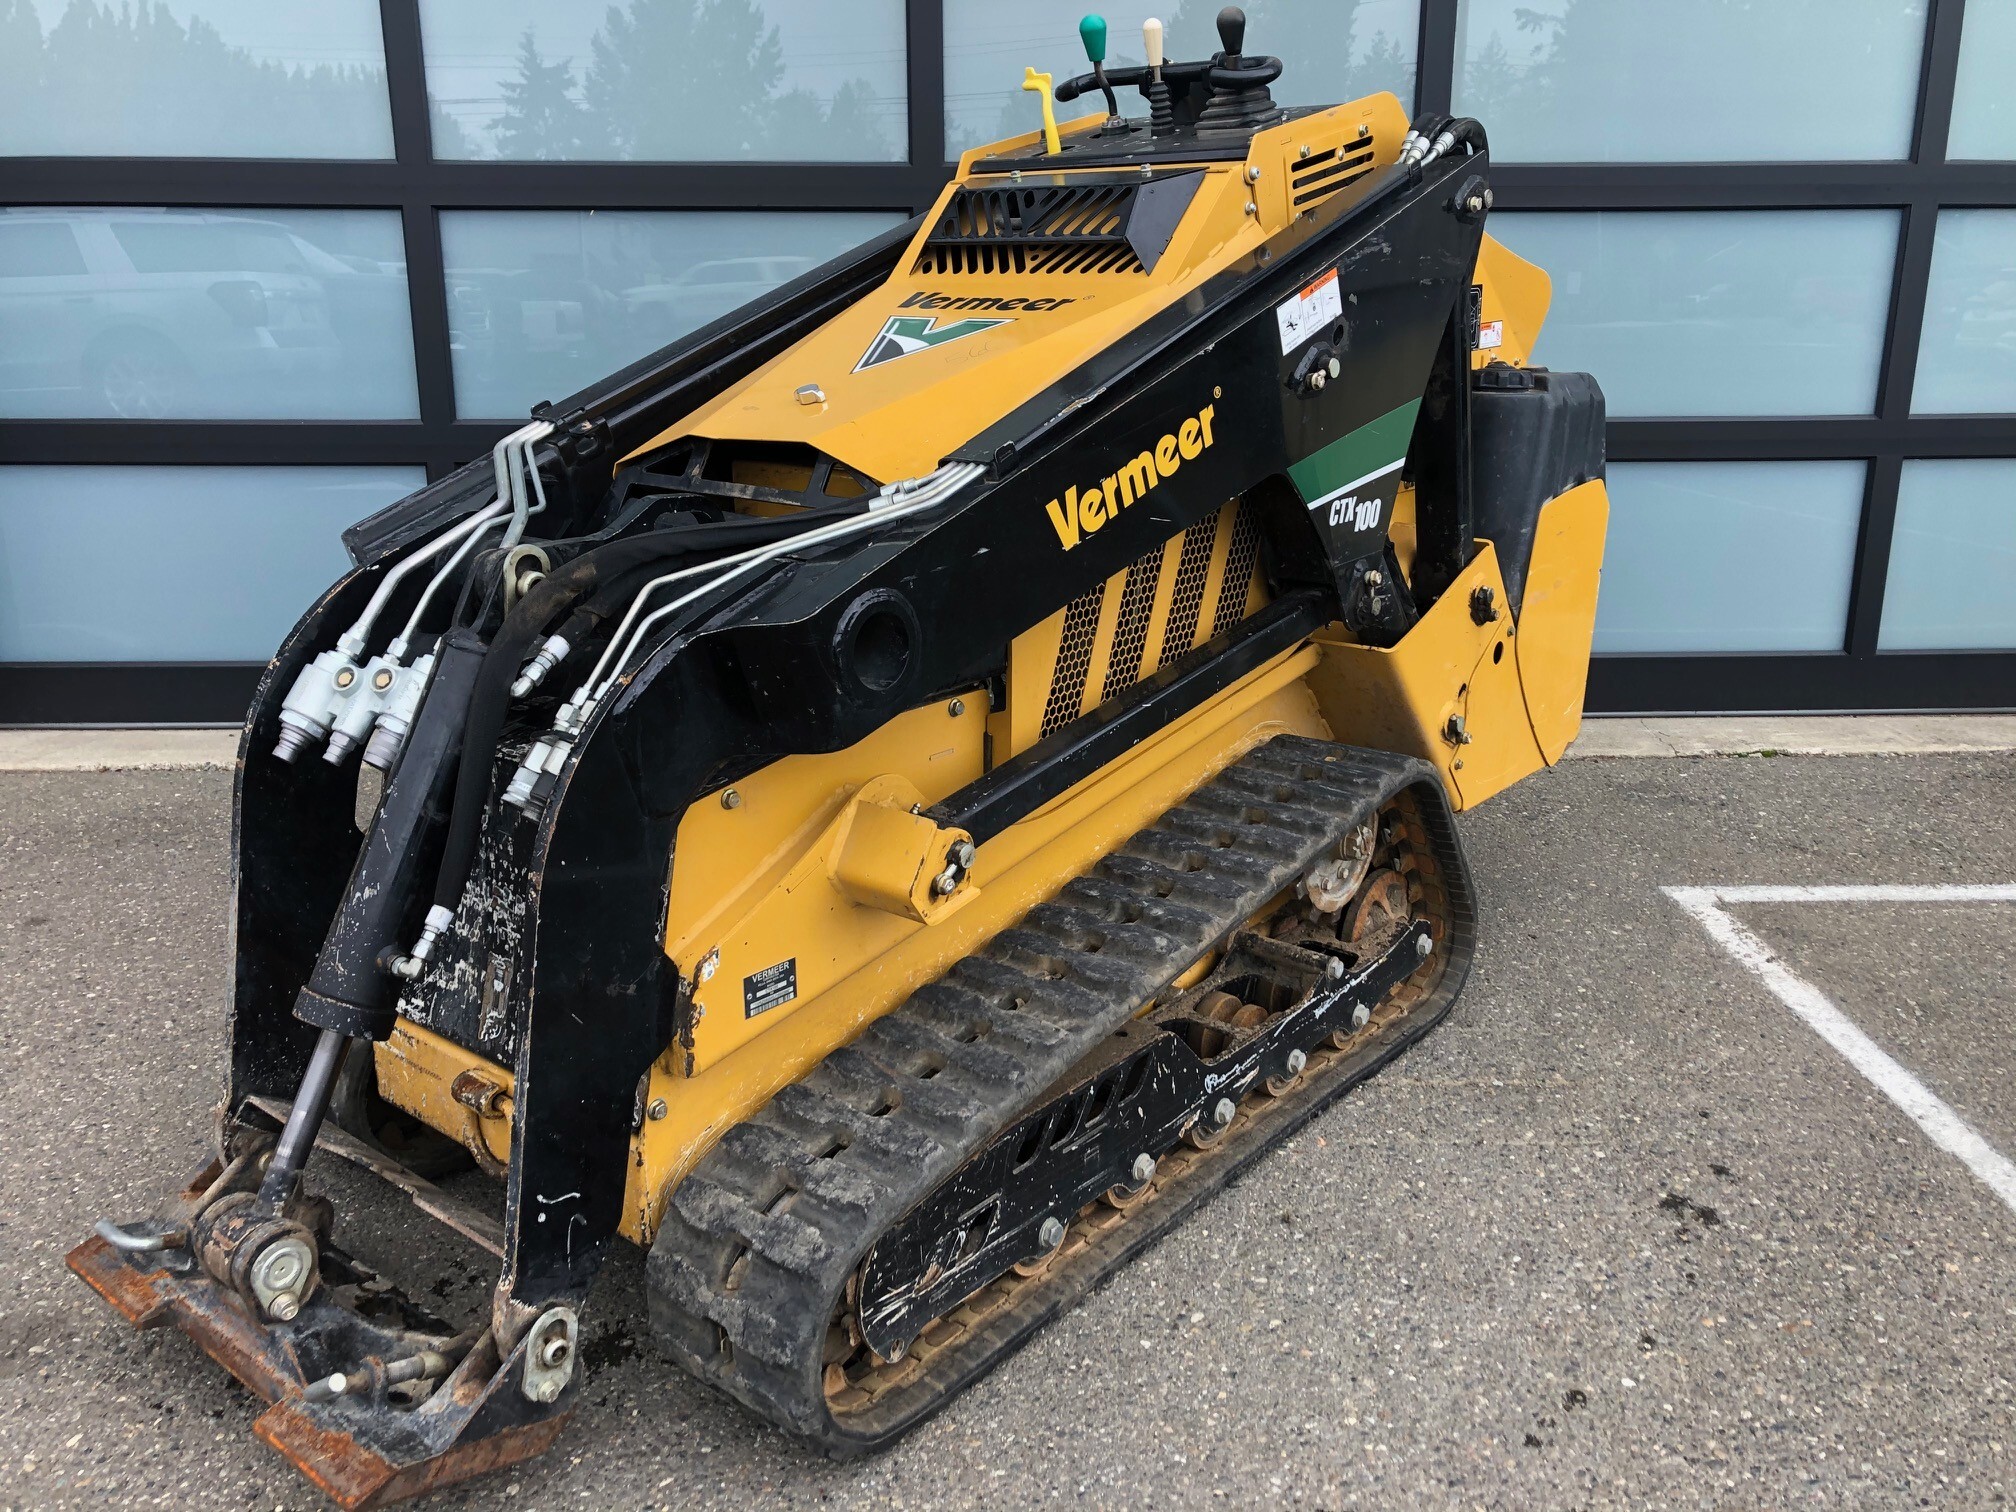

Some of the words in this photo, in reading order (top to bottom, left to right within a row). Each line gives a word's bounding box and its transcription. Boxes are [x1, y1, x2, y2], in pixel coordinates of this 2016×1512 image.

[898, 292, 1077, 311] Vermeer
[1045, 404, 1215, 551] Vermeer
[752, 962, 789, 983] VERMEER
